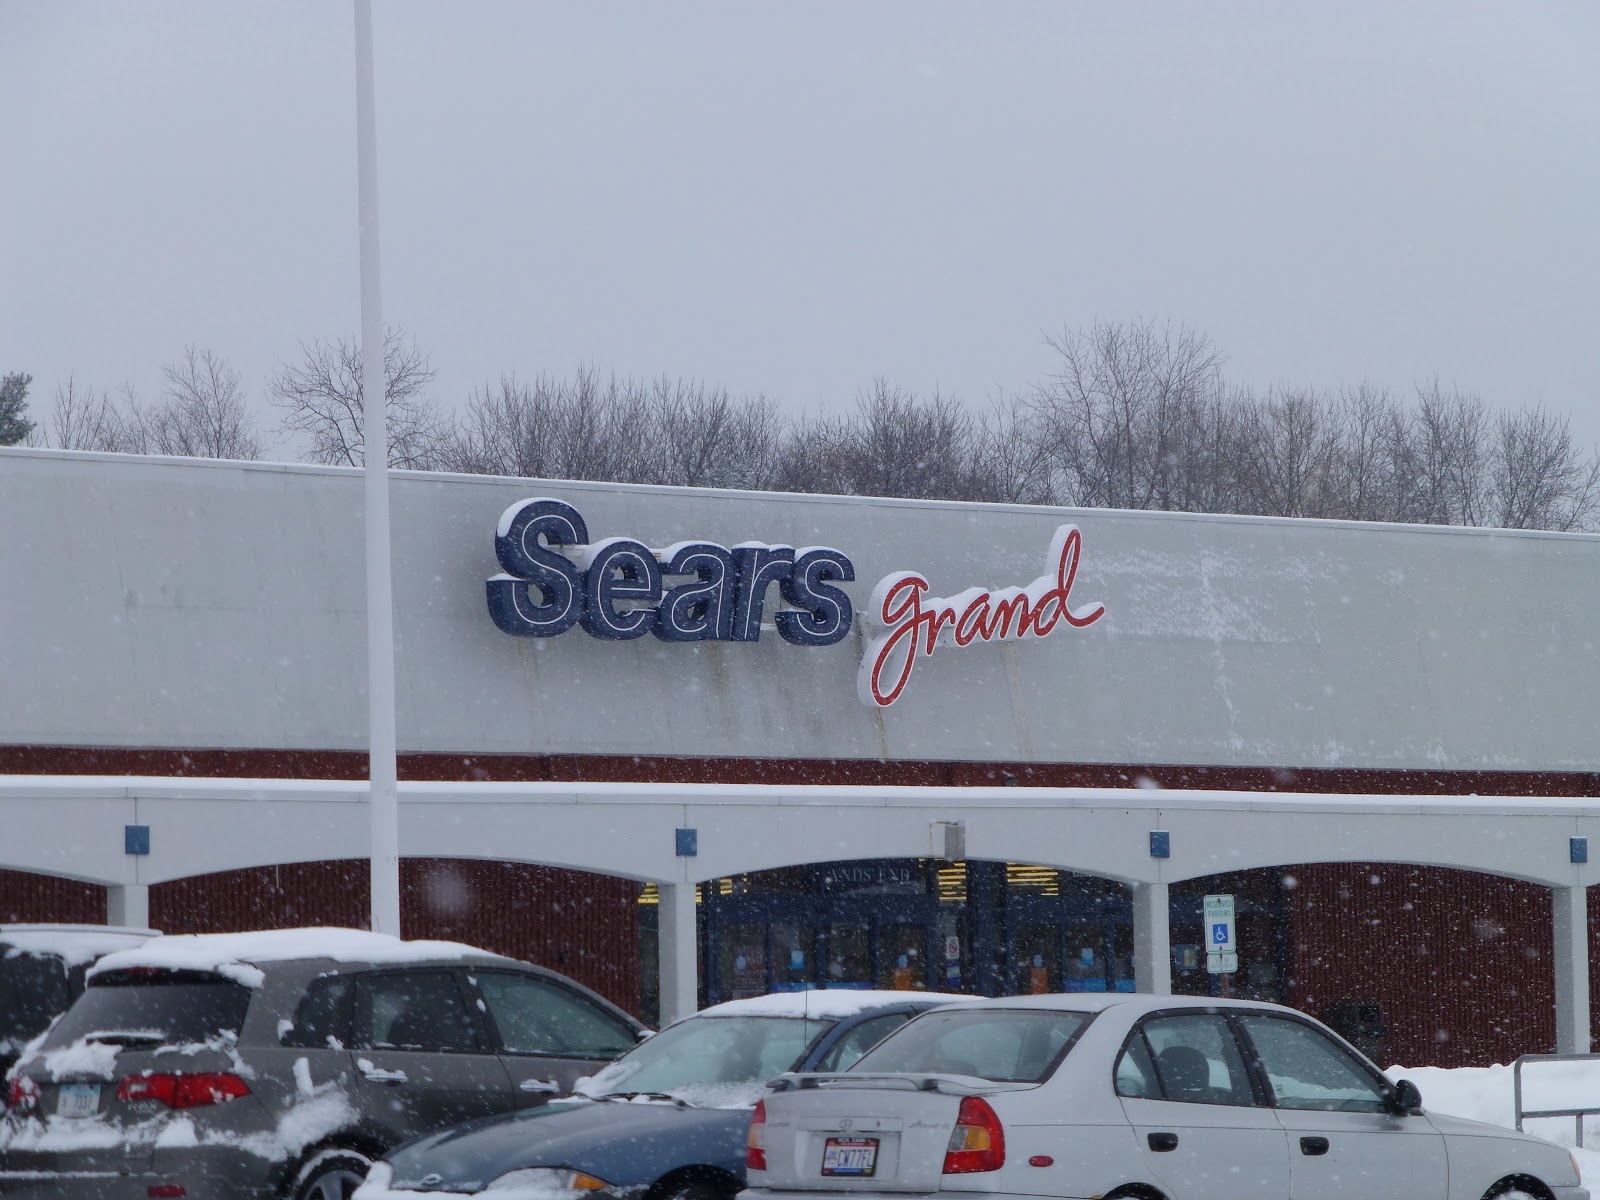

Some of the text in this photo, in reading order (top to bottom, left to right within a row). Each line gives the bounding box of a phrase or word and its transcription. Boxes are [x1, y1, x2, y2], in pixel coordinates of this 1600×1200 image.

[486, 497, 1105, 707] Sears grand
[1207, 909, 1232, 918] PARKING
